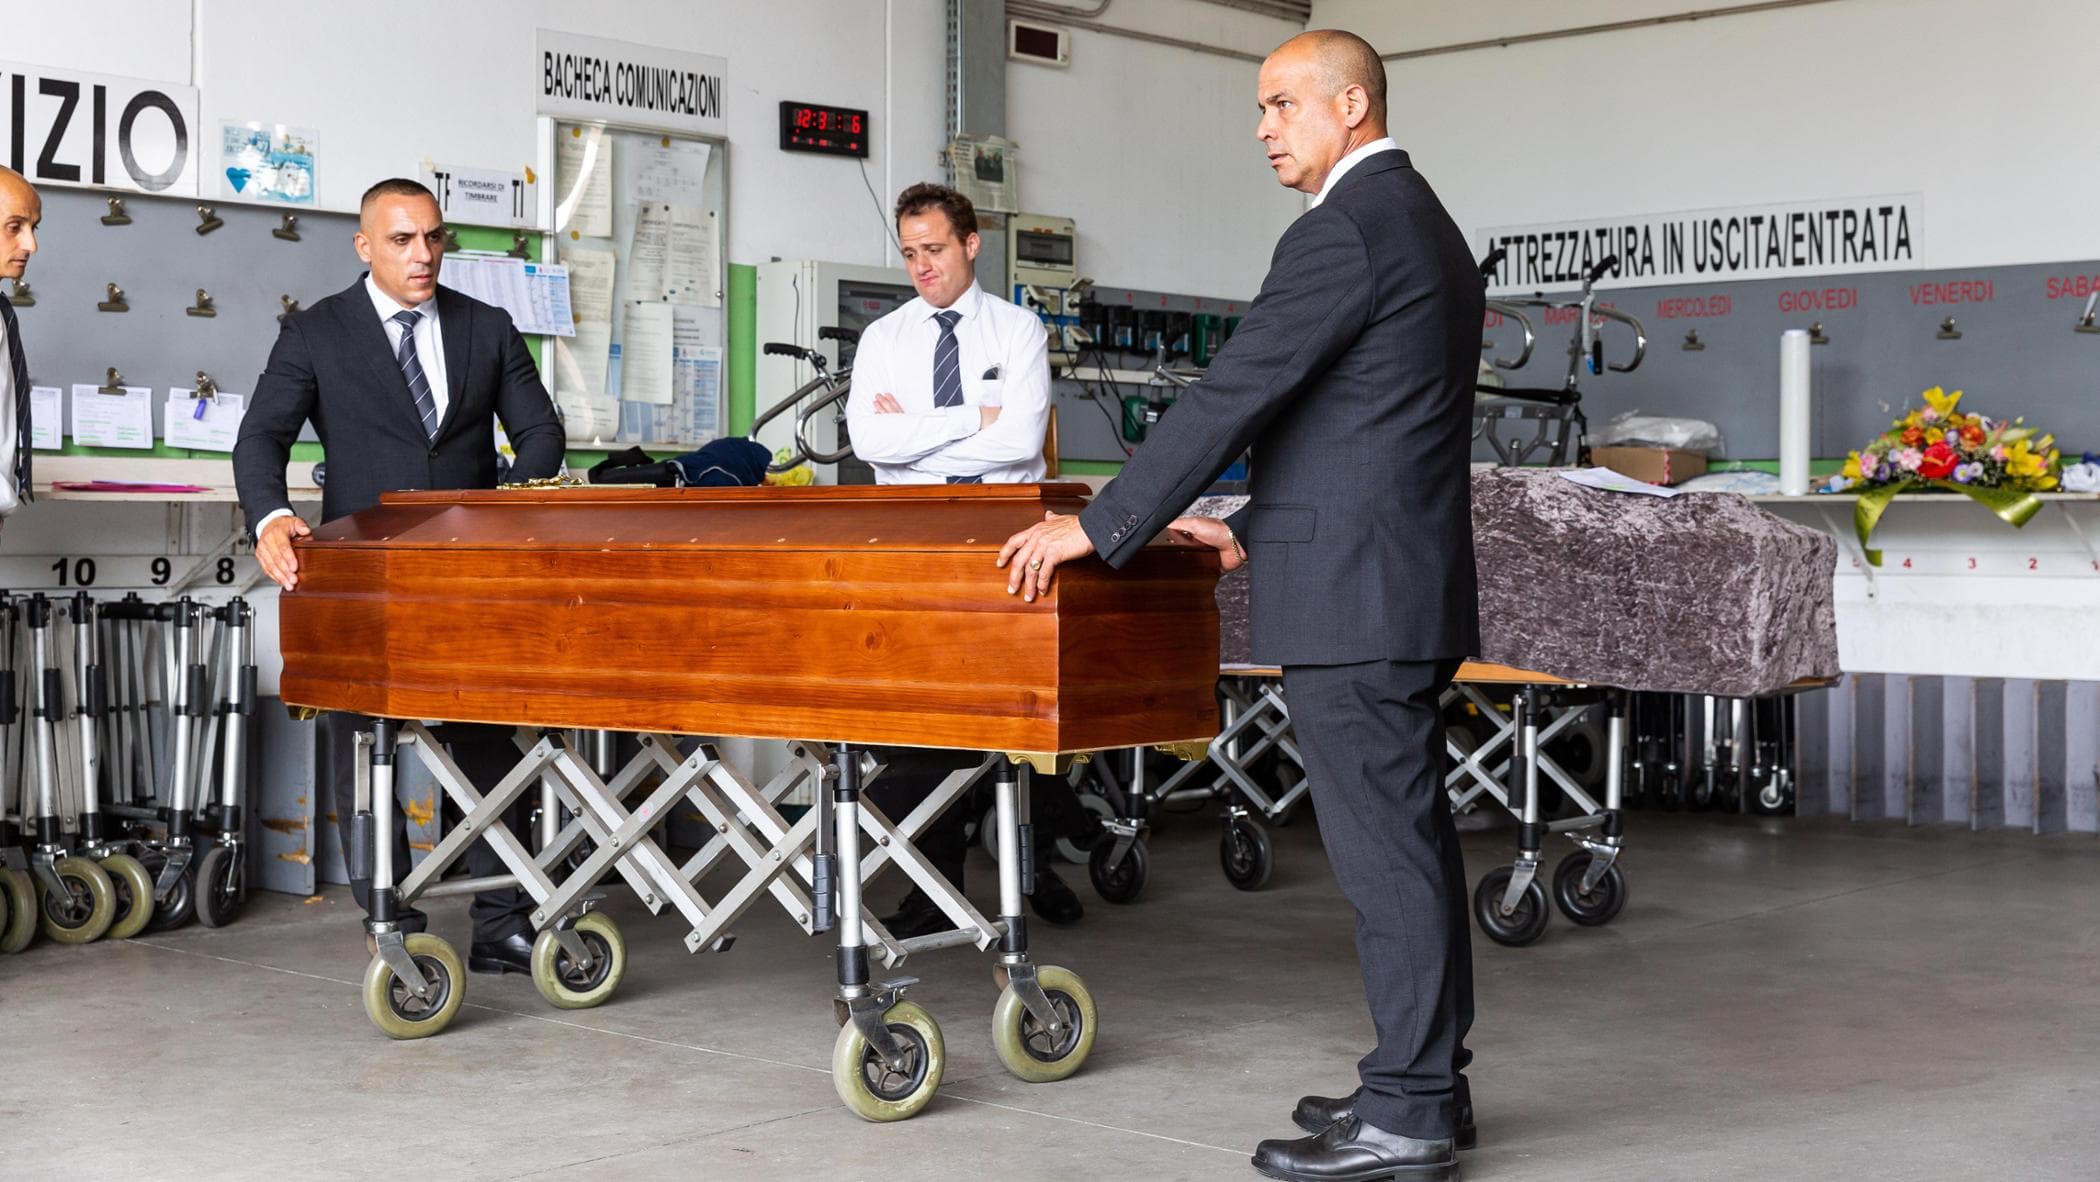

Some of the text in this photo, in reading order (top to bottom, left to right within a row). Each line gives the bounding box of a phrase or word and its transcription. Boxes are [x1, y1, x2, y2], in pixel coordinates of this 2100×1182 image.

[544, 51, 721, 119] BACHECA COMUNICAZIONI
[0, 72, 188, 192] IZIO
[458, 179, 497, 191] RICORDARSI
[465, 191, 498, 203] TIMBRARE
[1487, 205, 1913, 287] ATTREZZATURA IN USCITA/ENTRATA
[1778, 288, 1858, 313] GIOVEDI
[1910, 280, 1994, 306] VENERDI
[1657, 294, 1732, 320] MERCOLEDI
[52, 557, 96, 586] 10
[151, 557, 172, 585] 9
[216, 557, 235, 585] 8
[1903, 557, 1912, 569] 4
[1968, 557, 1977, 569] 3
[2028, 558, 2038, 570] 2
